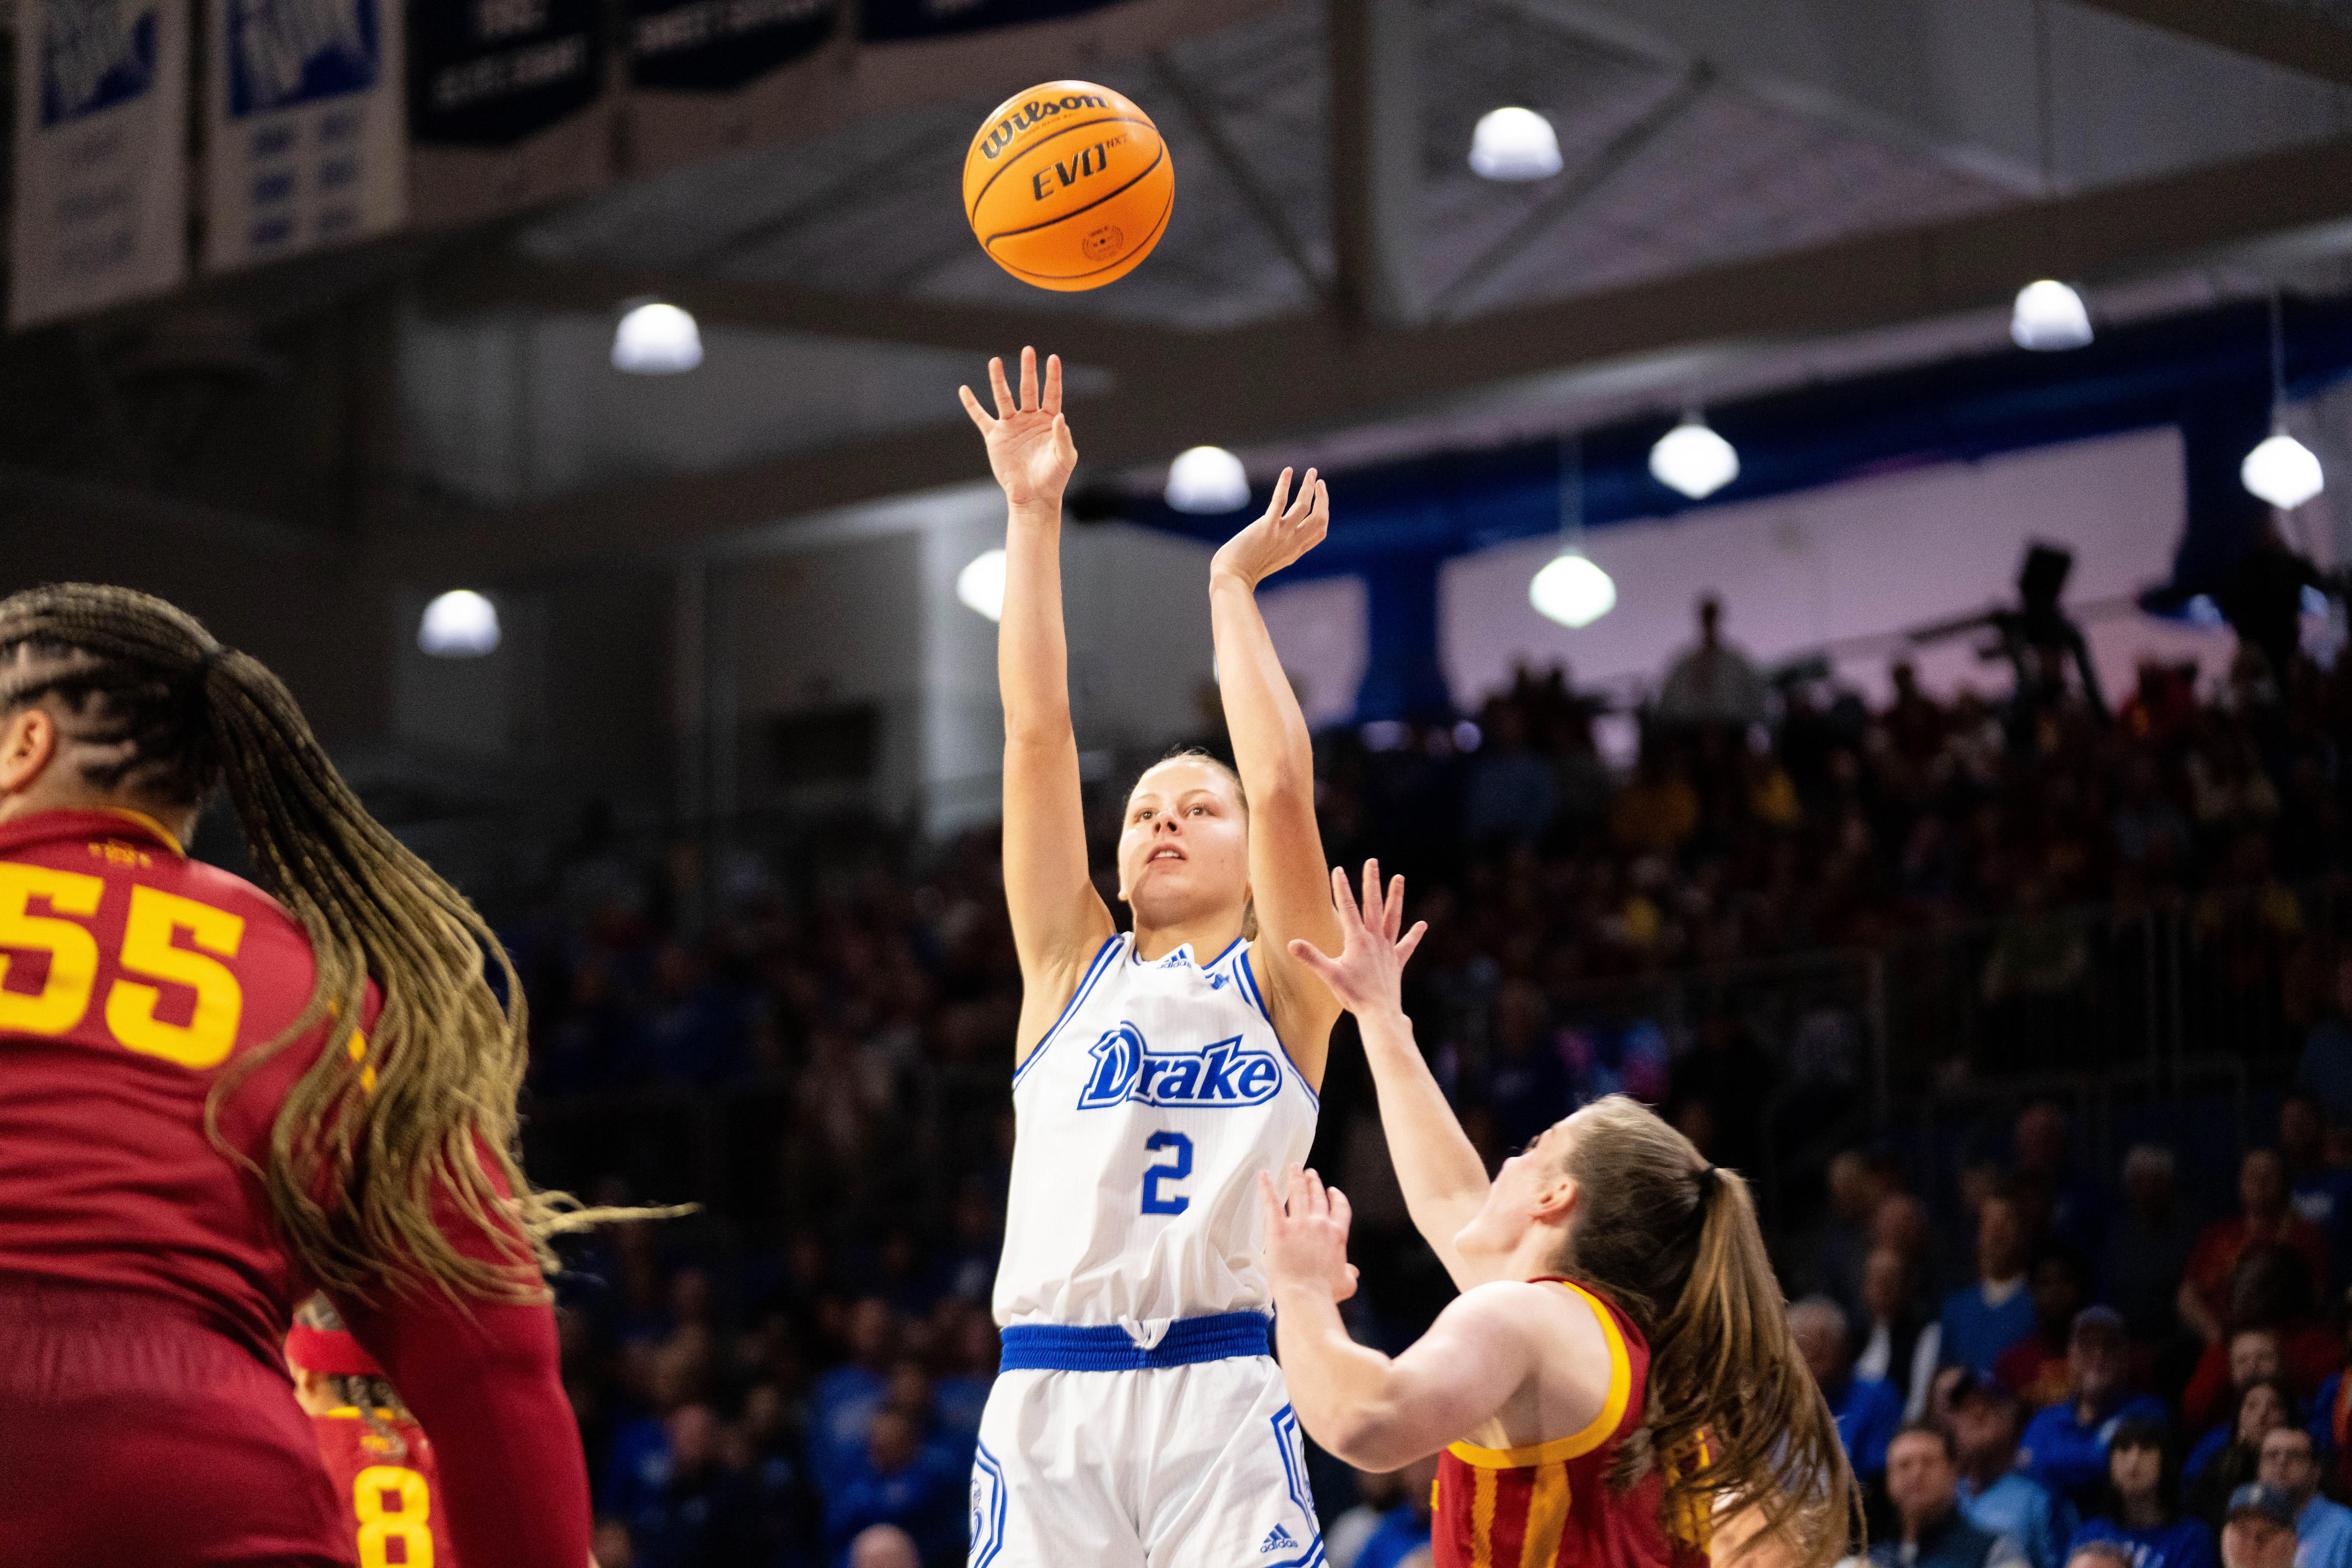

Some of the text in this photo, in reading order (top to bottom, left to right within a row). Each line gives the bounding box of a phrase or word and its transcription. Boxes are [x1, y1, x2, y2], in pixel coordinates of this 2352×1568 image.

[980, 94, 1109, 161] Wilson
[1077, 1020, 1282, 1110] Drake
[1141, 1130, 1193, 1216] 2
[353, 1466, 434, 1568] 8
[1260, 1538, 1298, 1553] adidas
